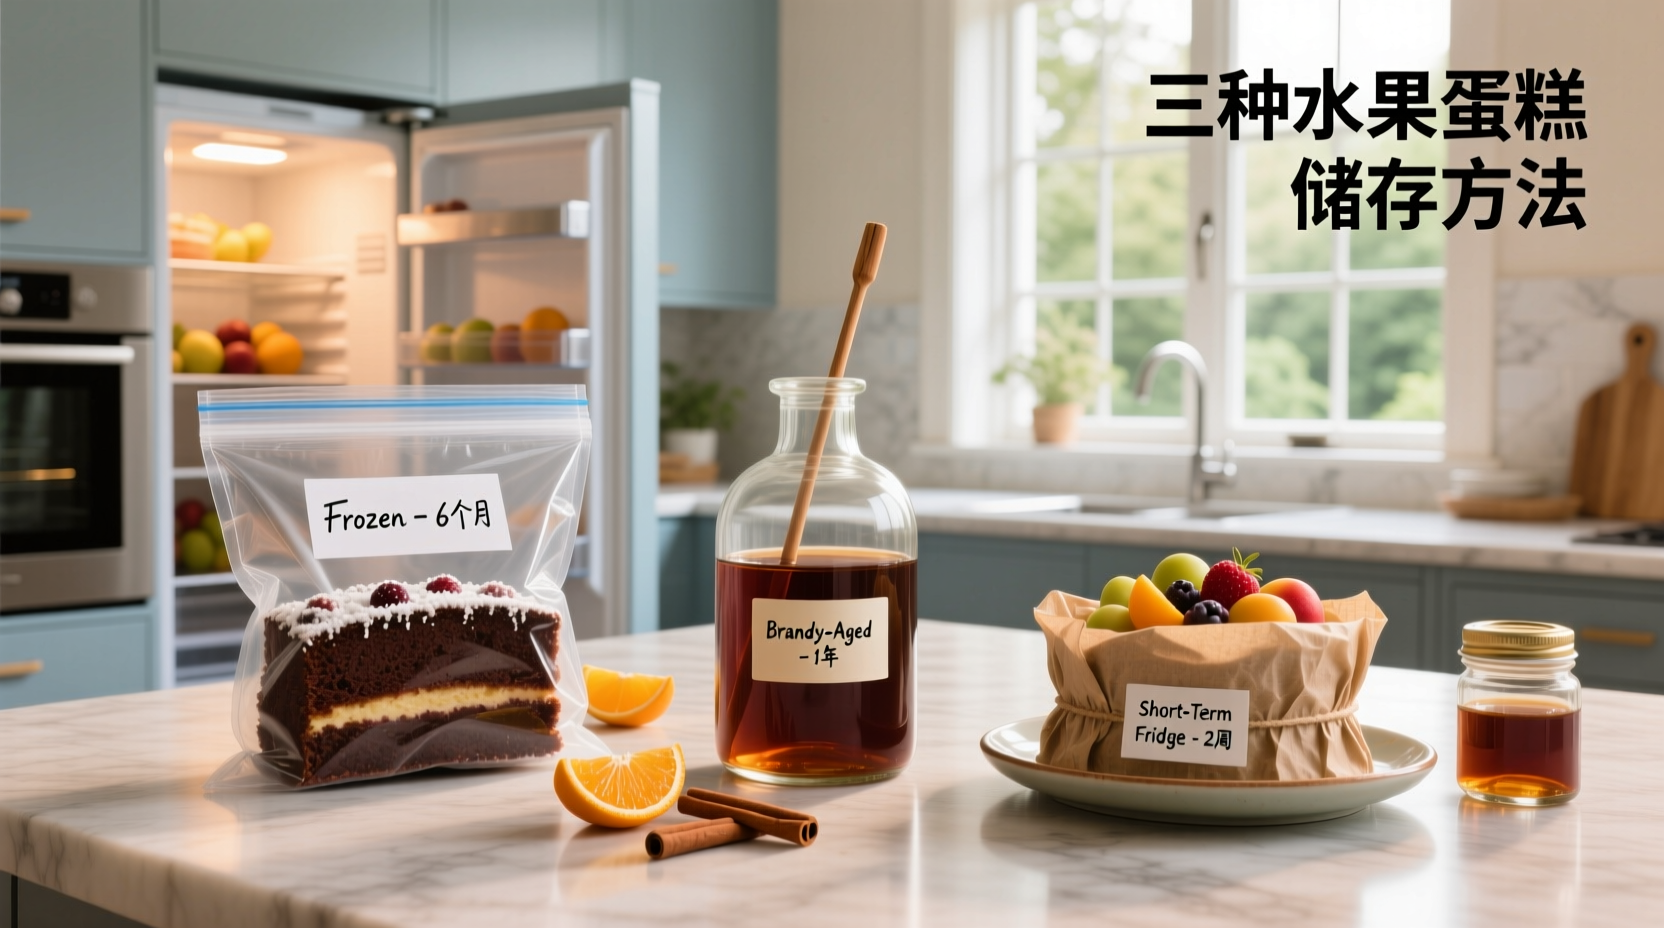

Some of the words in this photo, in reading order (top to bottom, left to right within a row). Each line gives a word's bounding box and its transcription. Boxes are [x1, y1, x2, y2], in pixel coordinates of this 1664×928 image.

[323, 499, 407, 534] Frozen
[436, 499, 491, 530] 6个月
[766, 619, 872, 646] Brandy-Aged
[814, 644, 839, 668] 1年
[1138, 699, 1232, 722] Short-Term
[1135, 725, 1186, 750] Fridge
